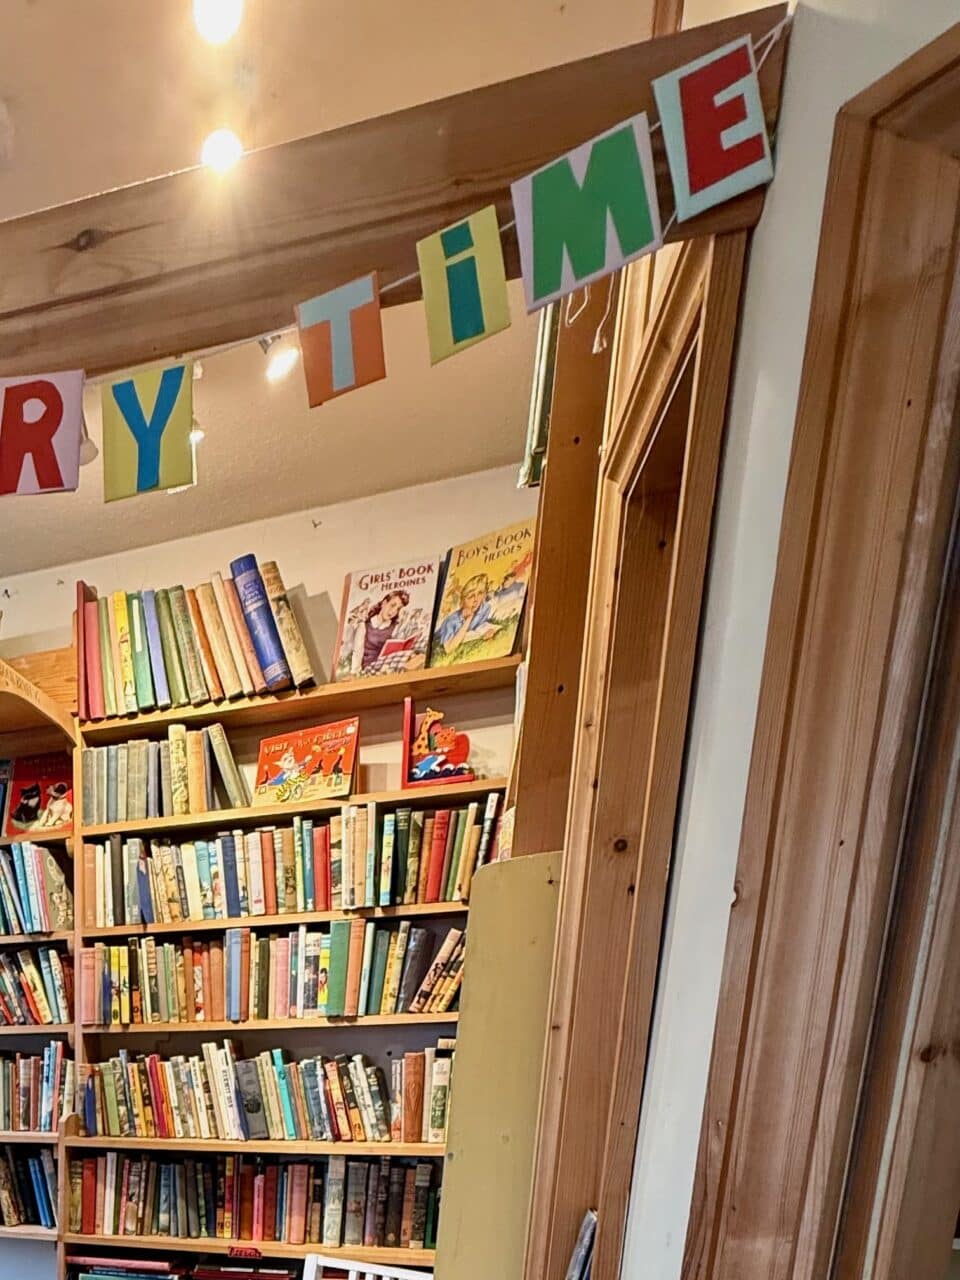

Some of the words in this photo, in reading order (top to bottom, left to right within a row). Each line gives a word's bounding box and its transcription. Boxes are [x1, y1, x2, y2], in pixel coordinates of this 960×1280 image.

[496, 528, 531, 549] BOOK
[484, 545, 522, 564] HEROES
[399, 563, 434, 579] BOOK
[380, 577, 426, 591] HEROINES
